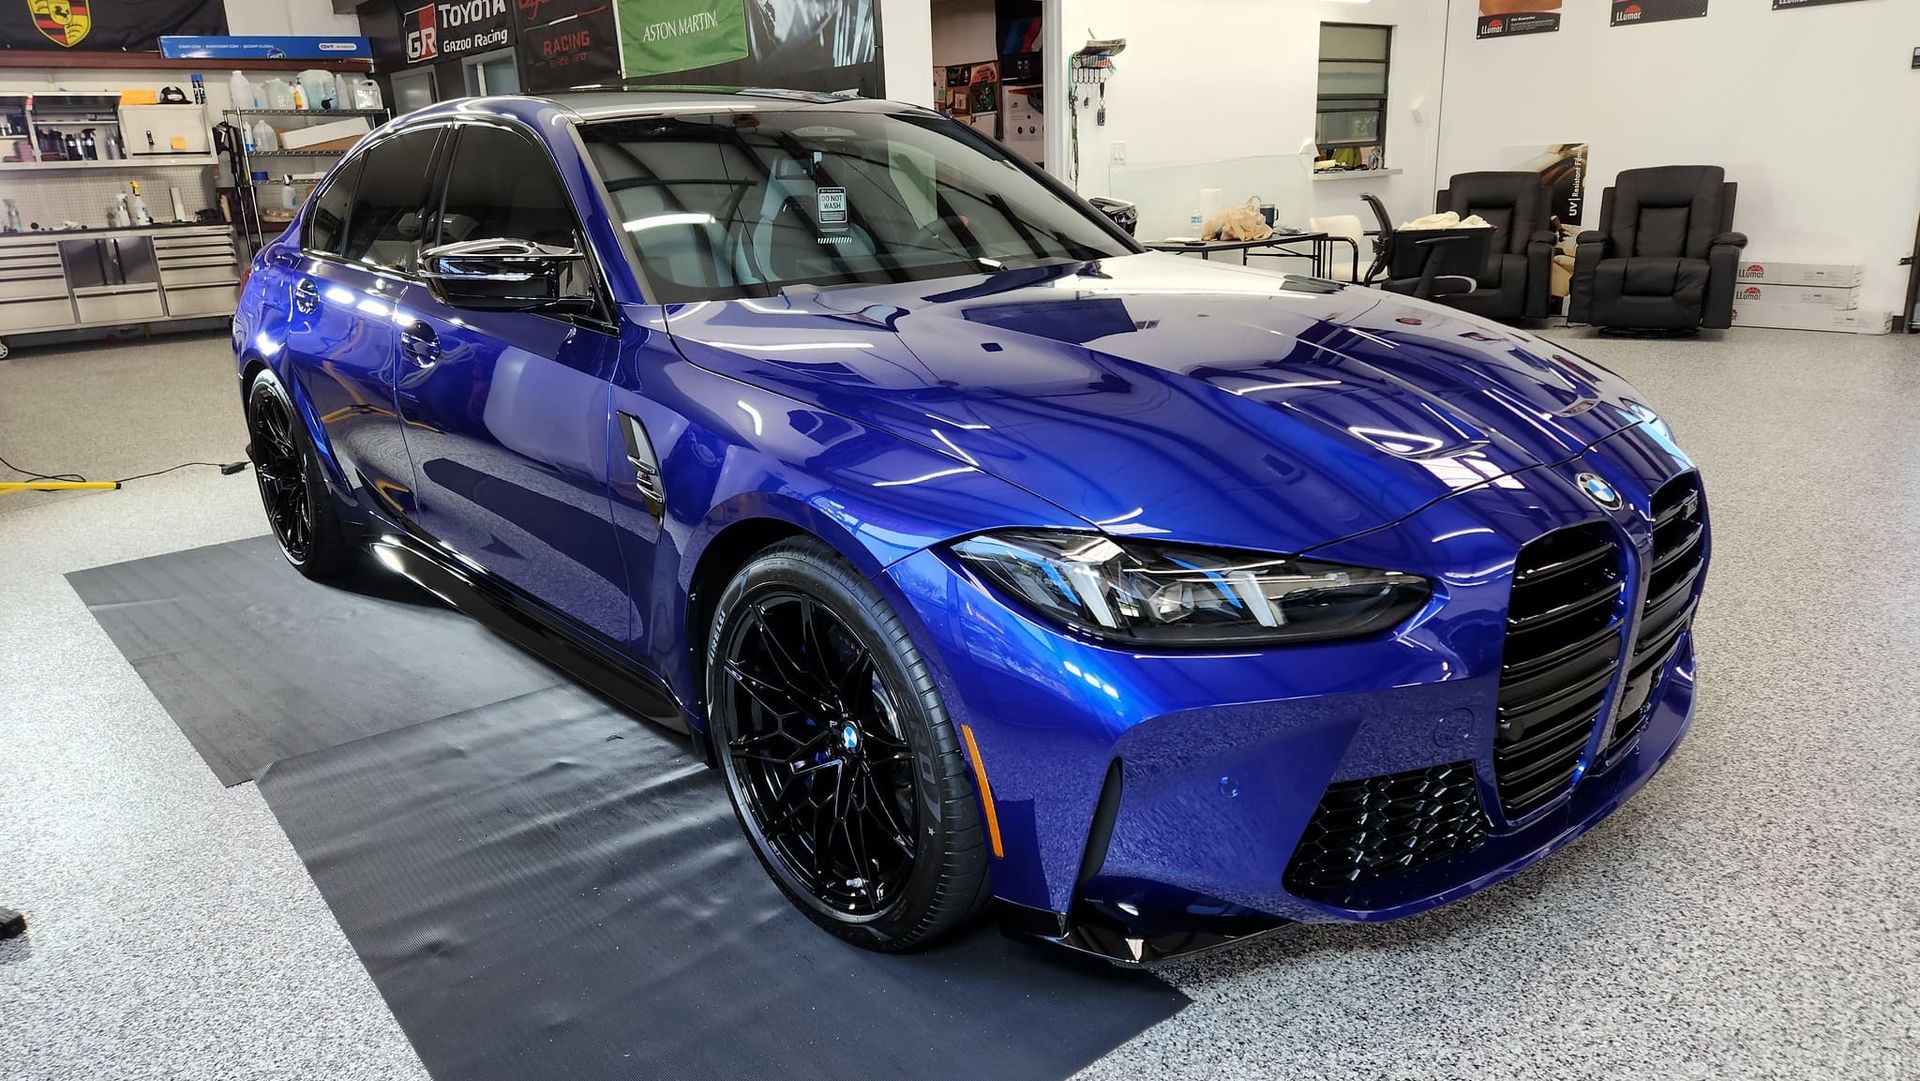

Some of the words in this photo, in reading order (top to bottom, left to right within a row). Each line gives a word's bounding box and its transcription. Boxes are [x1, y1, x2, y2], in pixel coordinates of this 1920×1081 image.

[438, 0, 506, 28] TOYOTA
[643, 20, 677, 43] ASTON
[679, 10, 717, 36] MARTIN
[407, 27, 436, 58] GR
[474, 29, 508, 47] Racing
[543, 30, 590, 56] RACING
[1569, 202, 1578, 216] UV
